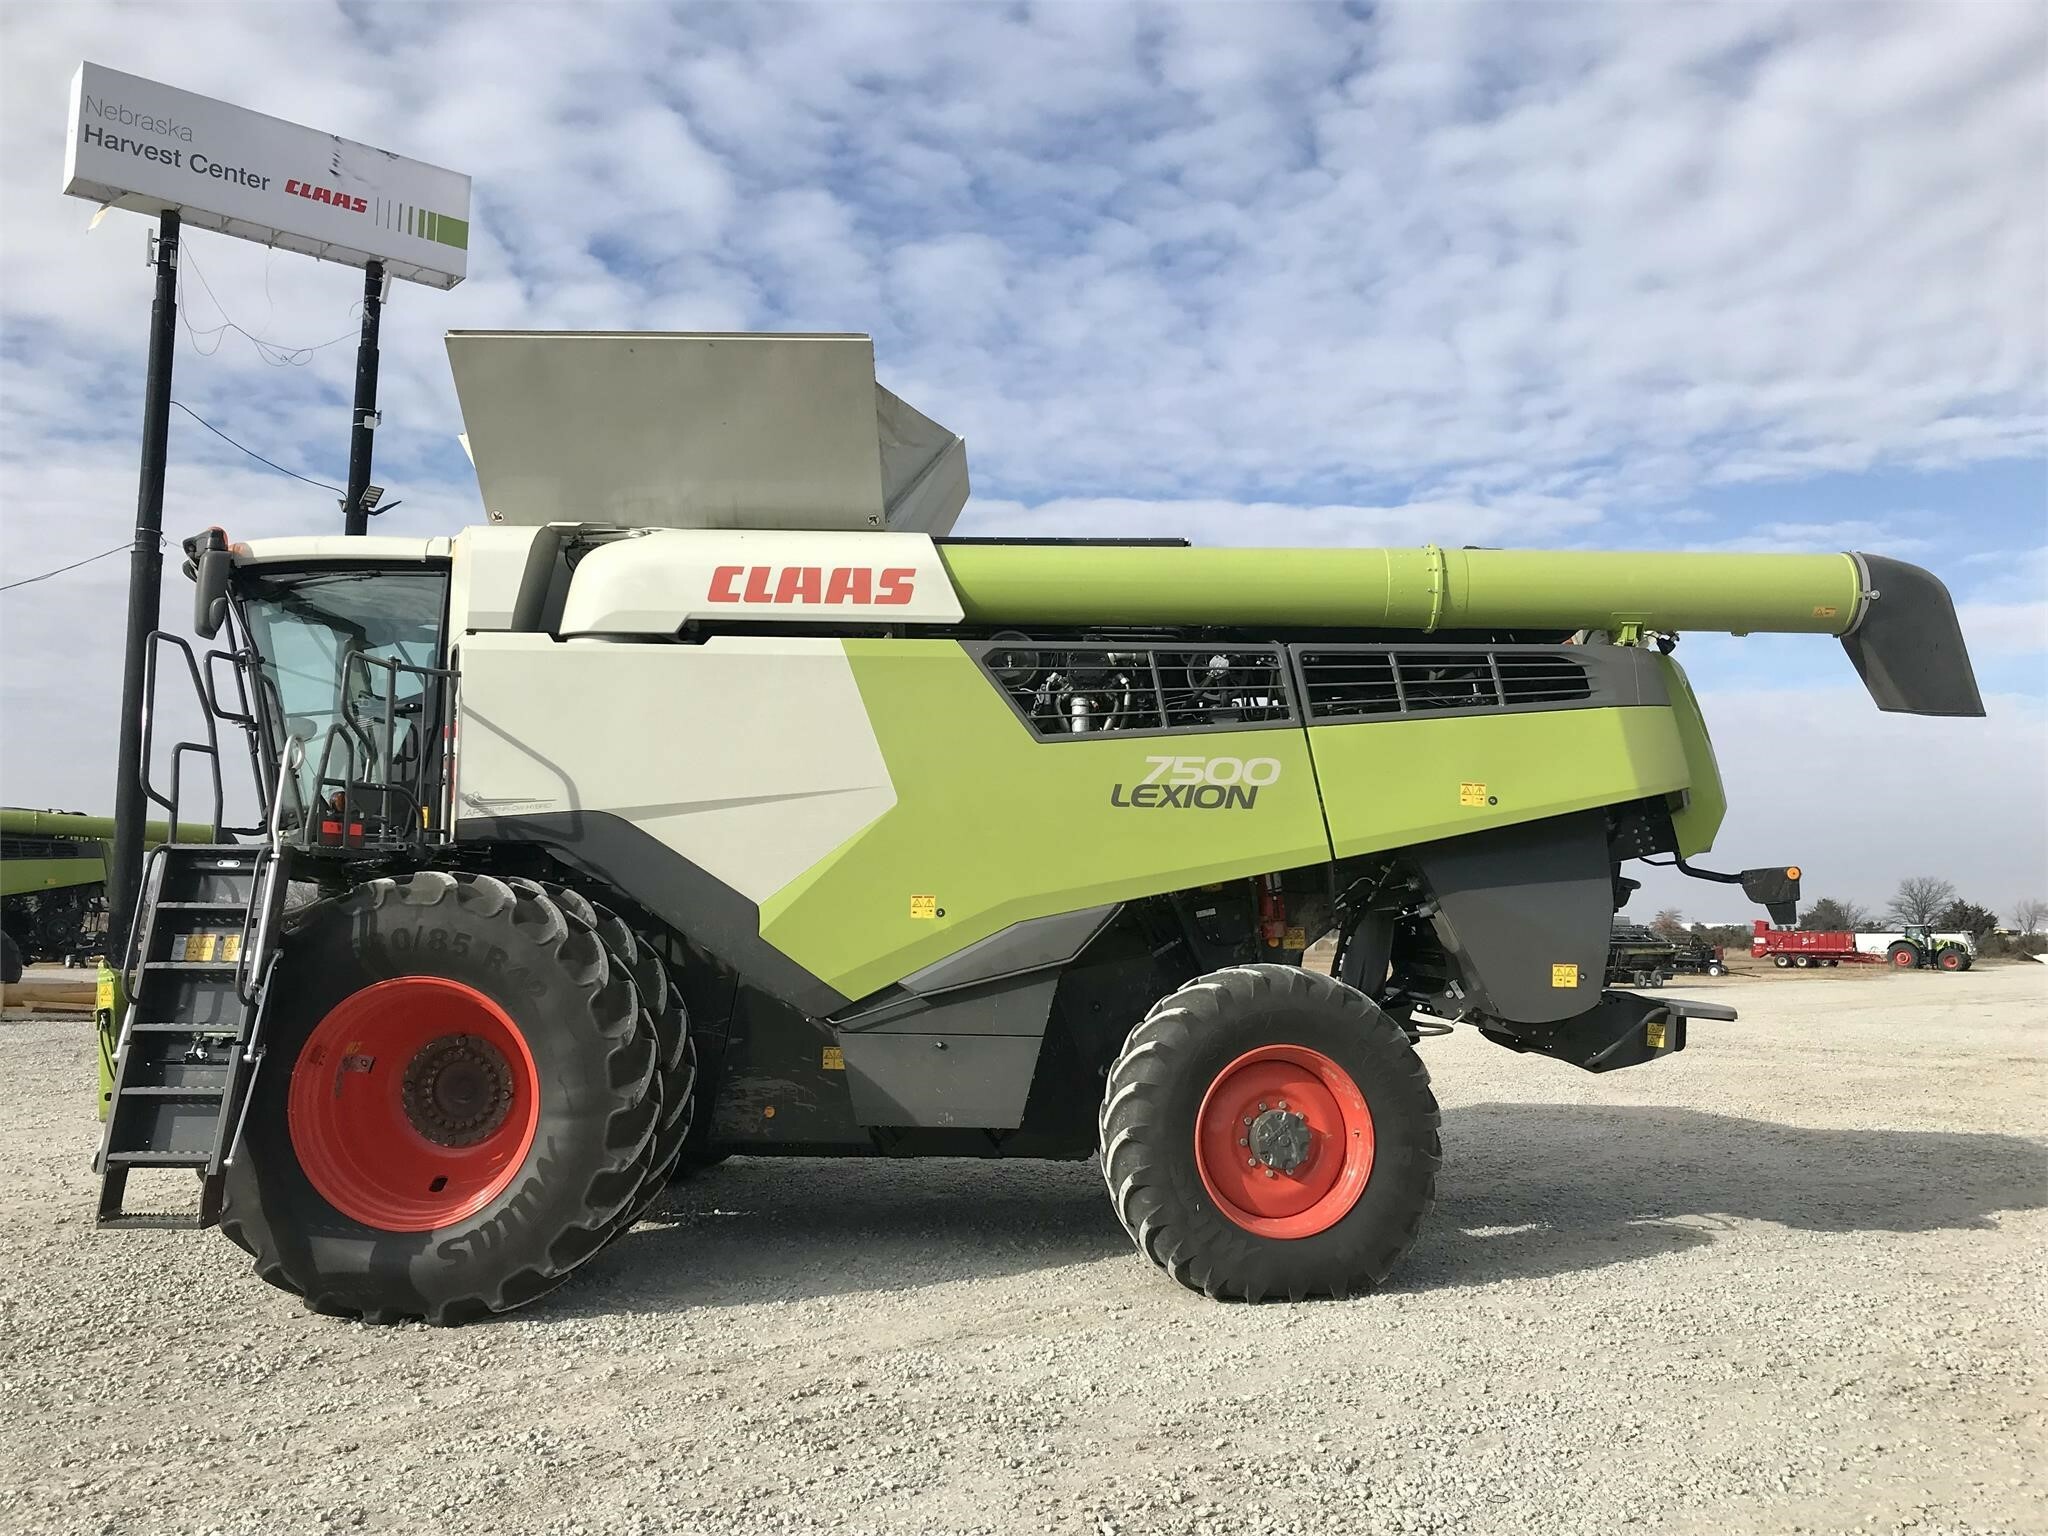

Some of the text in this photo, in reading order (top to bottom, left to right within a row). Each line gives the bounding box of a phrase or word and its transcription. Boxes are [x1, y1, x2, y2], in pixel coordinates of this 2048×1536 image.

[85, 95, 193, 143] Nebraska
[84, 124, 270, 191] Harvest Center
[285, 179, 369, 214] CLAAS
[707, 566, 916, 605] CLAAS
[1141, 756, 1281, 787] 7500
[1111, 784, 1258, 810] LEXION
